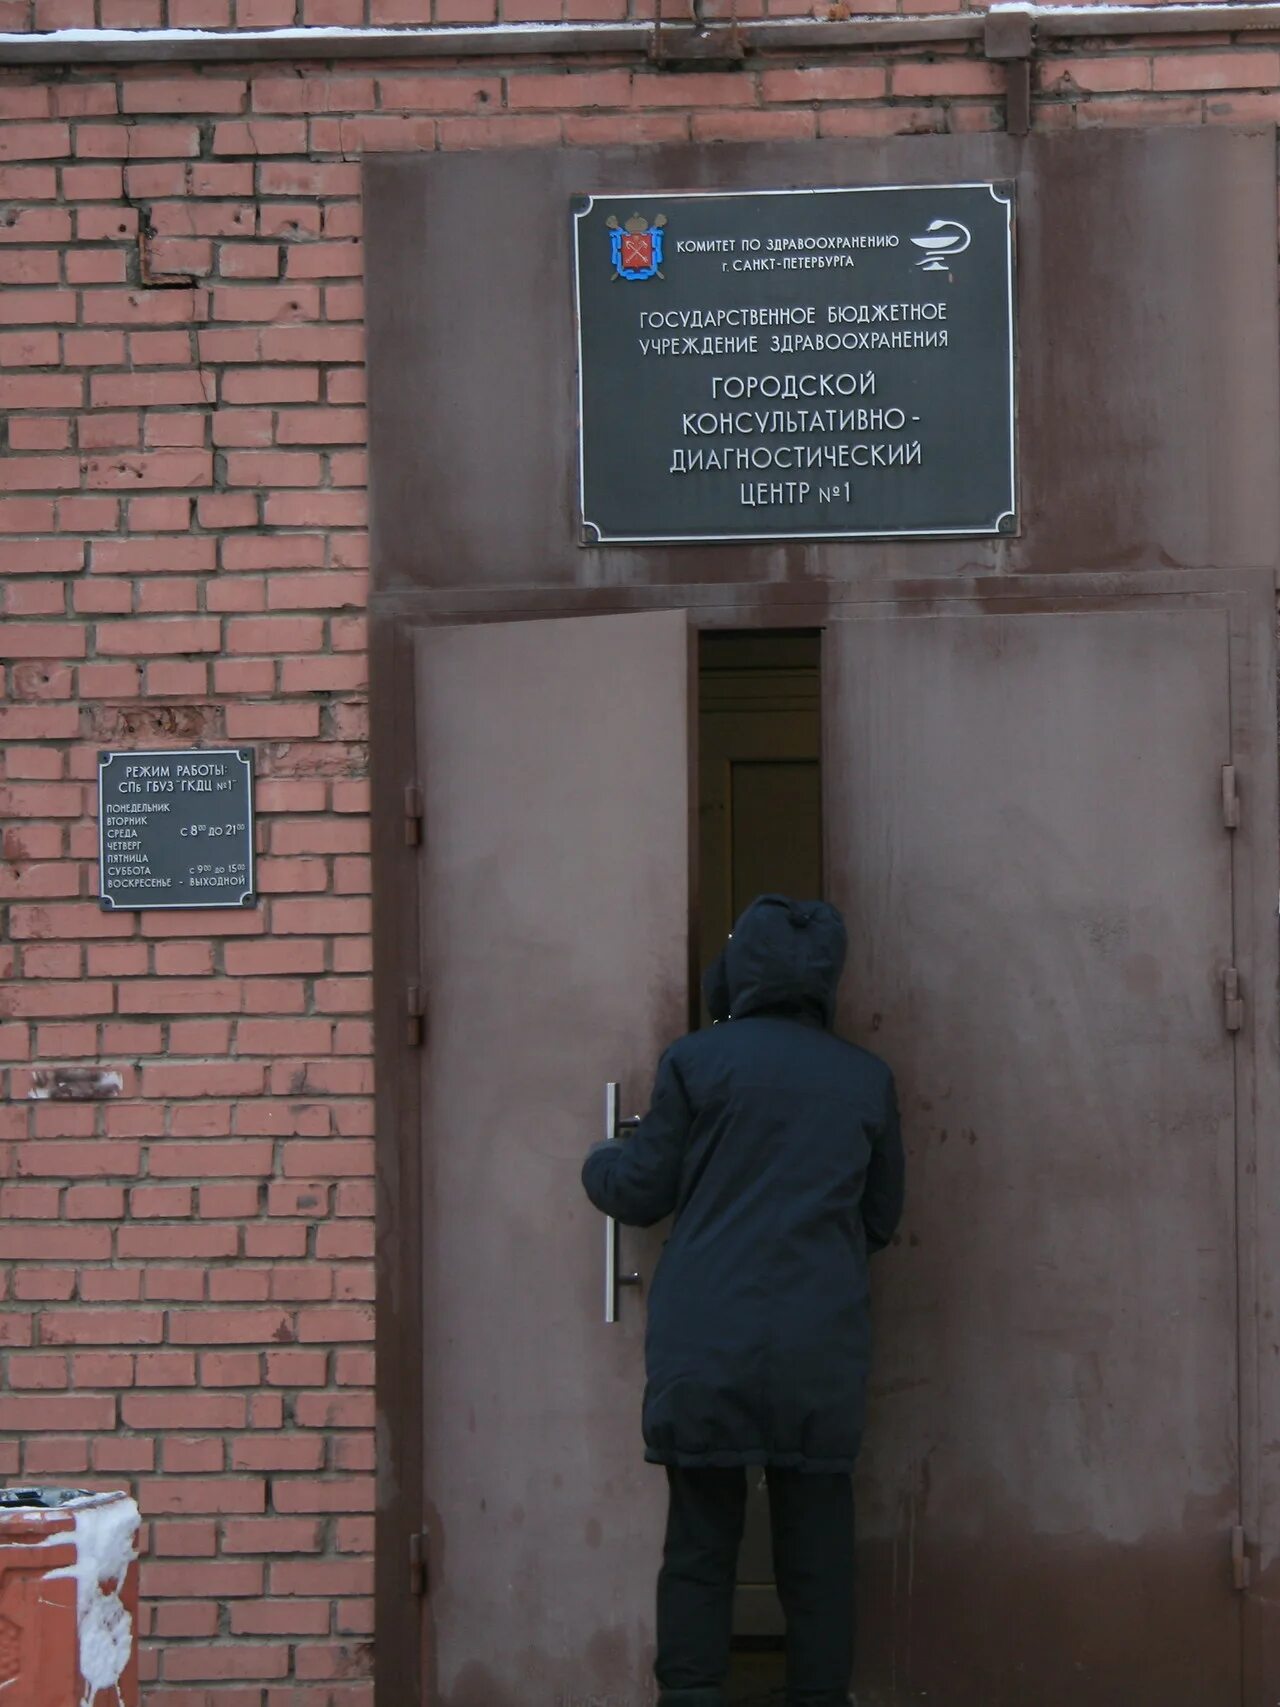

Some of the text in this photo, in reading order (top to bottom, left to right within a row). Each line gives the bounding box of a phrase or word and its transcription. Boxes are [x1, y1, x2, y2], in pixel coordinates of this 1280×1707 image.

[677, 234, 900, 253] КОМИТЕТ ПО ЗДРАВООХРАНЕНИЮ
[733, 255, 855, 272] САНКТ-ПЕТЕРБУРГА
[640, 303, 947, 329] ГОСУДАРСТВЕННОЕ БЮДЖЕТНОЕ
[639, 330, 949, 356] УЧРЕЖДЕНИЕ ЗДРАВООХРАНЕНИЯ
[712, 370, 876, 400] ГОРОДСКОЙ
[670, 440, 923, 474] ДИАГНОСТИЧЕСКИЙ
[740, 482, 811, 506] ЦЕНТР
[126, 764, 228, 778] РЕЖИМ РАБОТЫ:
[146, 780, 174, 792] ГБУЗ
[106, 803, 171, 813] ПОНЕДЕЛЬНИК
[107, 817, 148, 826] ВТОРНИК
[107, 829, 138, 838] СРЕДА
[107, 841, 142, 851] ЧЕТВЕРГ
[107, 854, 149, 864] ПЯТНИЦА
[107, 866, 151, 876] СУББОТА
[108, 878, 172, 888] ВОСКРЕСЕНЬЕ
[190, 875, 246, 887] ВЫХОДНОЙ
